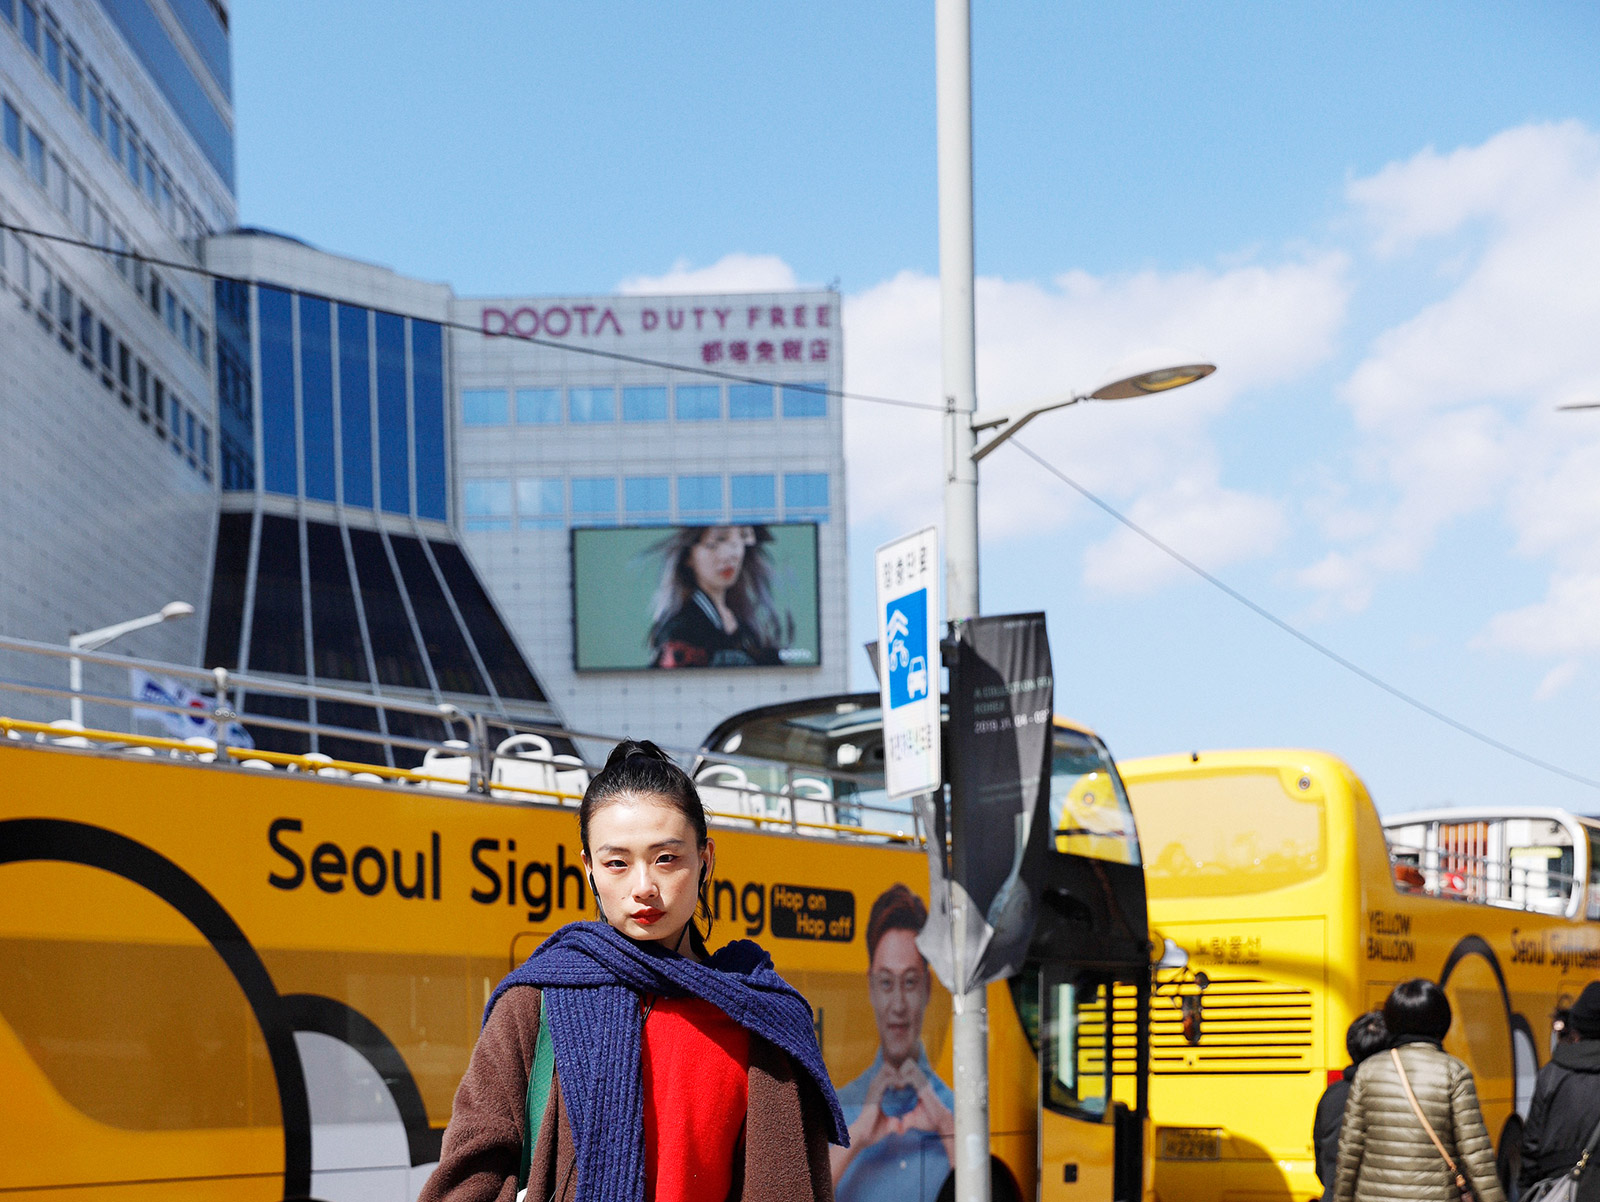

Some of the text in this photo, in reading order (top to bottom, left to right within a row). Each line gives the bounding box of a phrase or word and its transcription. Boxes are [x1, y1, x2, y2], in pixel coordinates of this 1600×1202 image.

[482, 304, 831, 338] DOOTA DUTY FREE
[267, 817, 765, 937] Seoul Sighing
[773, 886, 827, 912] Hop on
[796, 913, 852, 938] Hop off
[1368, 910, 1411, 936] YELLOW
[1367, 937, 1416, 962] BALLOON
[1510, 926, 1545, 966] Seoul
